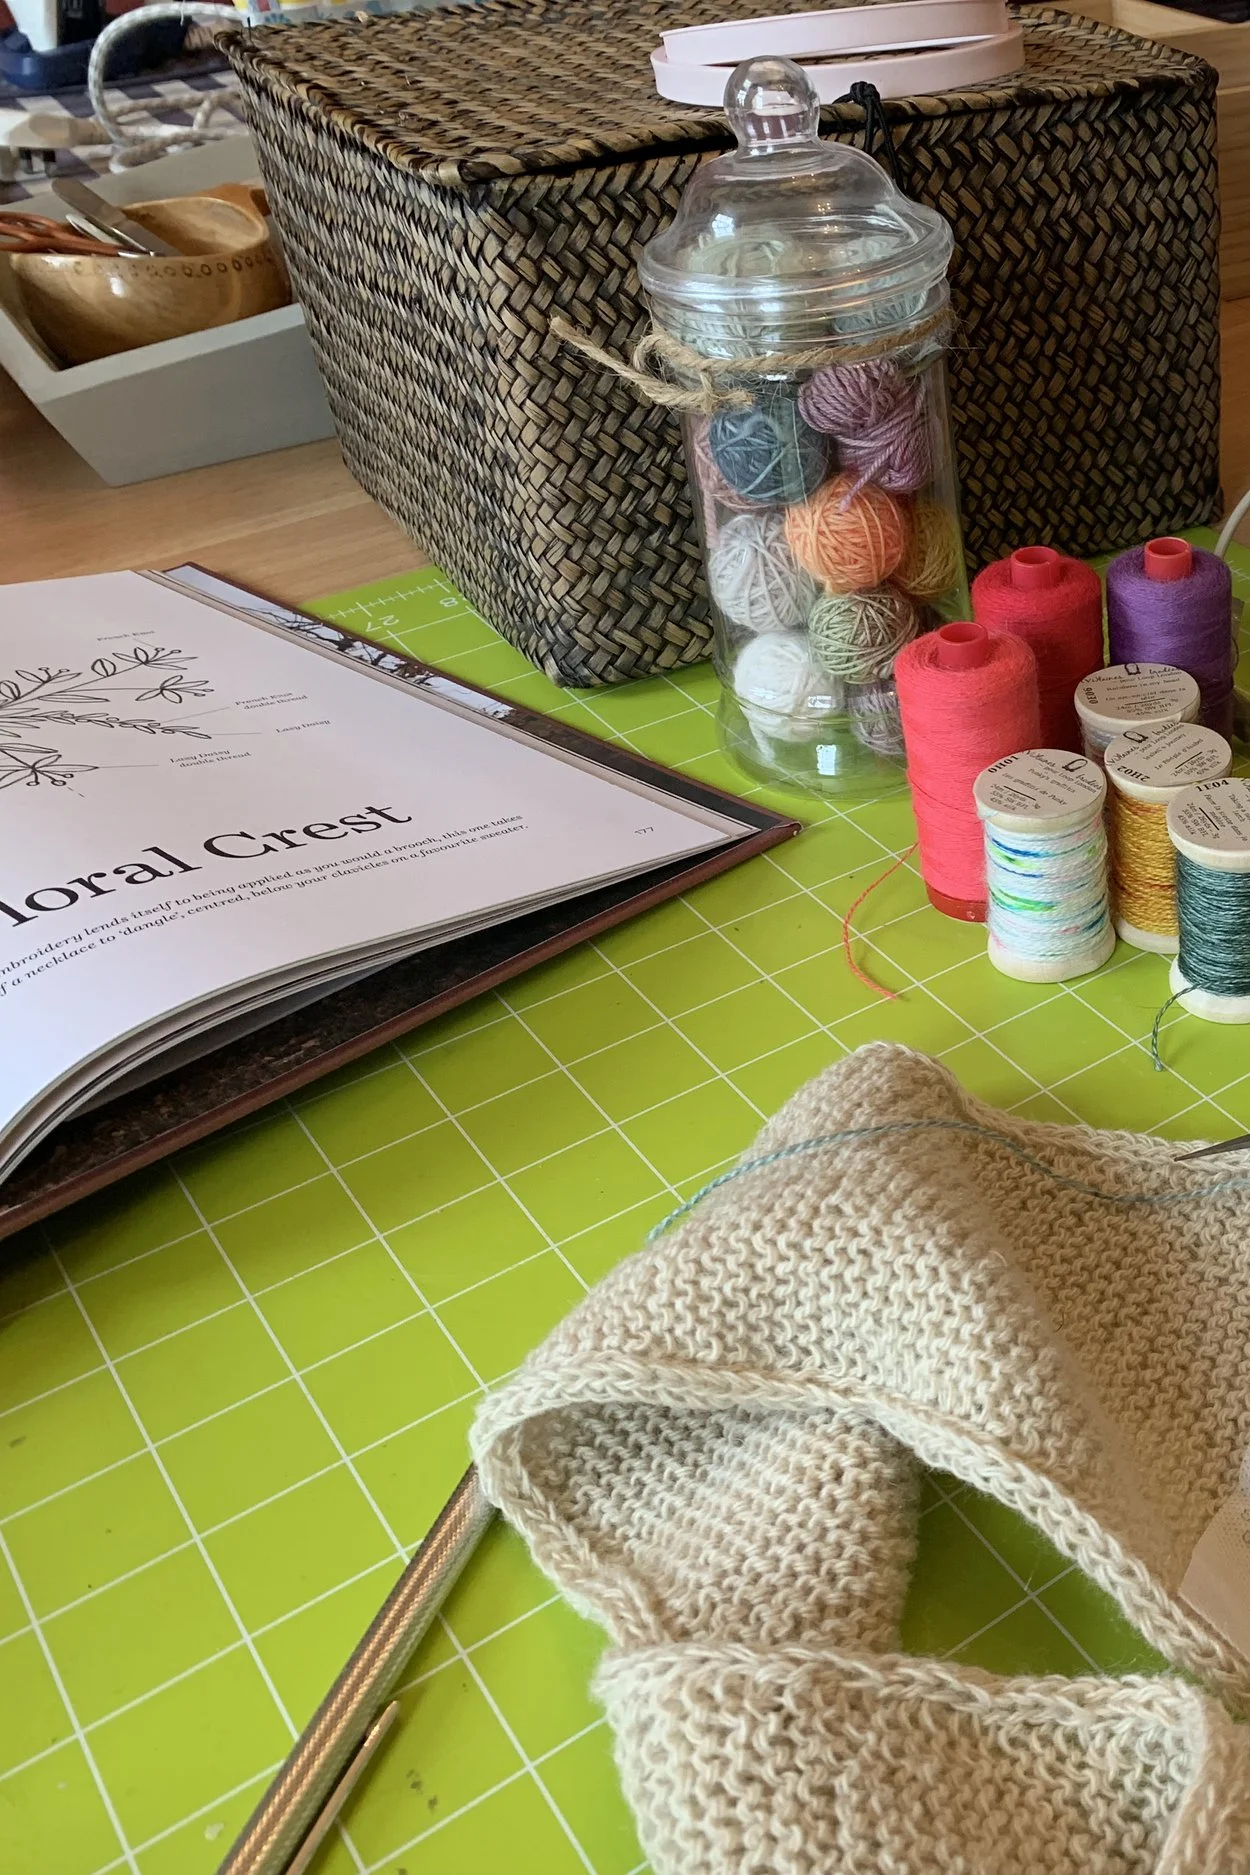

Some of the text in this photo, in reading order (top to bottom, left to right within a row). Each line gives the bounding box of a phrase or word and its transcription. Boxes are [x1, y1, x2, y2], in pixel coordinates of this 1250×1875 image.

[365, 615, 399, 632] 27
[277, 695, 308, 704] thread
[302, 719, 331, 729] Daisy
[179, 752, 252, 768] double thread
[198, 749, 230, 759] Daisy
[987, 755, 1020, 774] 0H01
[1117, 765, 1151, 782] 2H02
[1195, 779, 1229, 792] 1E04
[1226, 794, 1245, 809] Taking
[202, 806, 412, 859] Crest
[84, 915, 129, 936] lends
[130, 901, 172, 919] itself
[175, 897, 191, 906] to
[192, 886, 236, 901] being
[238, 871, 293, 889] applied
[296, 868, 311, 876] as
[313, 861, 338, 873] you
[340, 850, 383, 865] would
[393, 836, 442, 851] brooch,
[443, 829, 467, 840] this
[468, 823, 490, 833] one
[491, 814, 523, 826] takes
[11, 977, 23, 987] a
[24, 942, 96, 980] necklace
[99, 935, 116, 945] to
[187, 894, 251, 915] centred,
[250, 884, 293, 898] below
[294, 876, 327, 888] your
[331, 860, 389, 878] clavicles
[391, 856, 408, 864] on
[420, 837, 477, 858] favourite
[480, 825, 529, 841] sweater.
